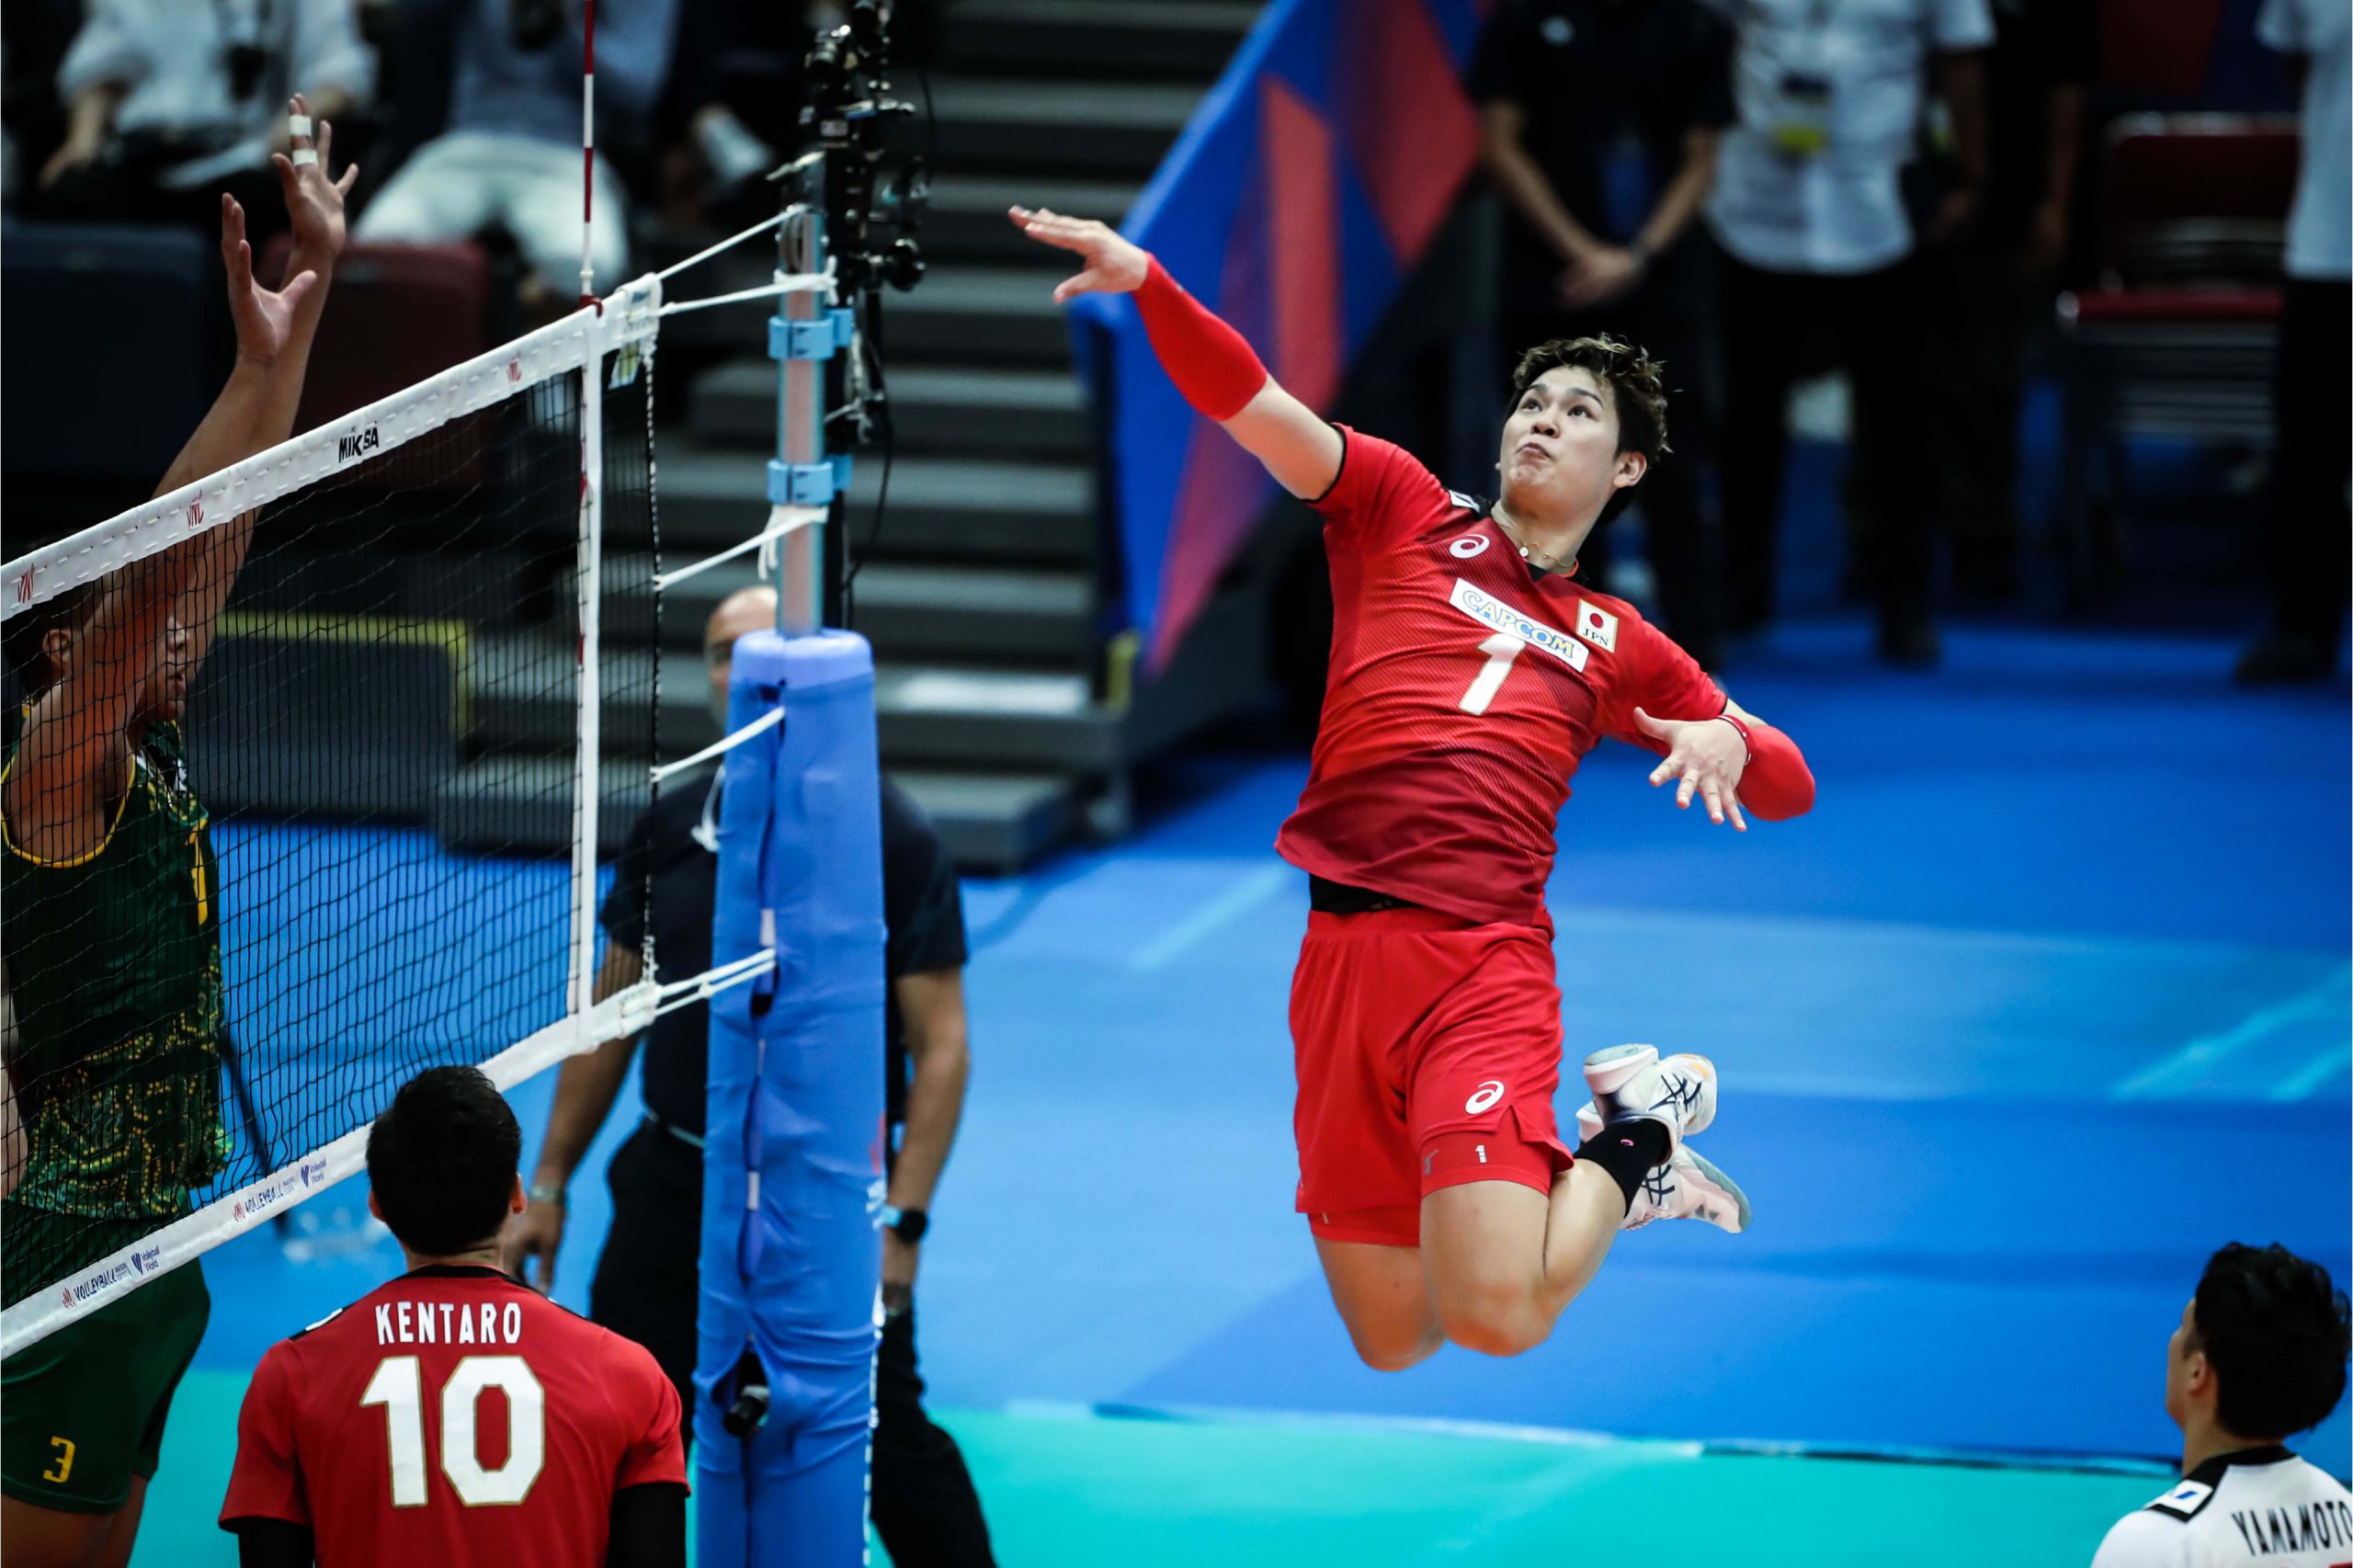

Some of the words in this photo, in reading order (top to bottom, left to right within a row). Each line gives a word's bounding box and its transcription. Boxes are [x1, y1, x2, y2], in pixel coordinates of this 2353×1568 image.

[1462, 589, 1575, 659] CAPCOM
[1583, 627, 1610, 647] JPN
[1457, 632, 1528, 716] 1
[1474, 1144, 1488, 1164] 1
[74, 1268, 117, 1301] VOLLEYBALL
[375, 1301, 522, 1346] KENTARO
[359, 1355, 545, 1508] 10
[43, 1436, 75, 1483] 3
